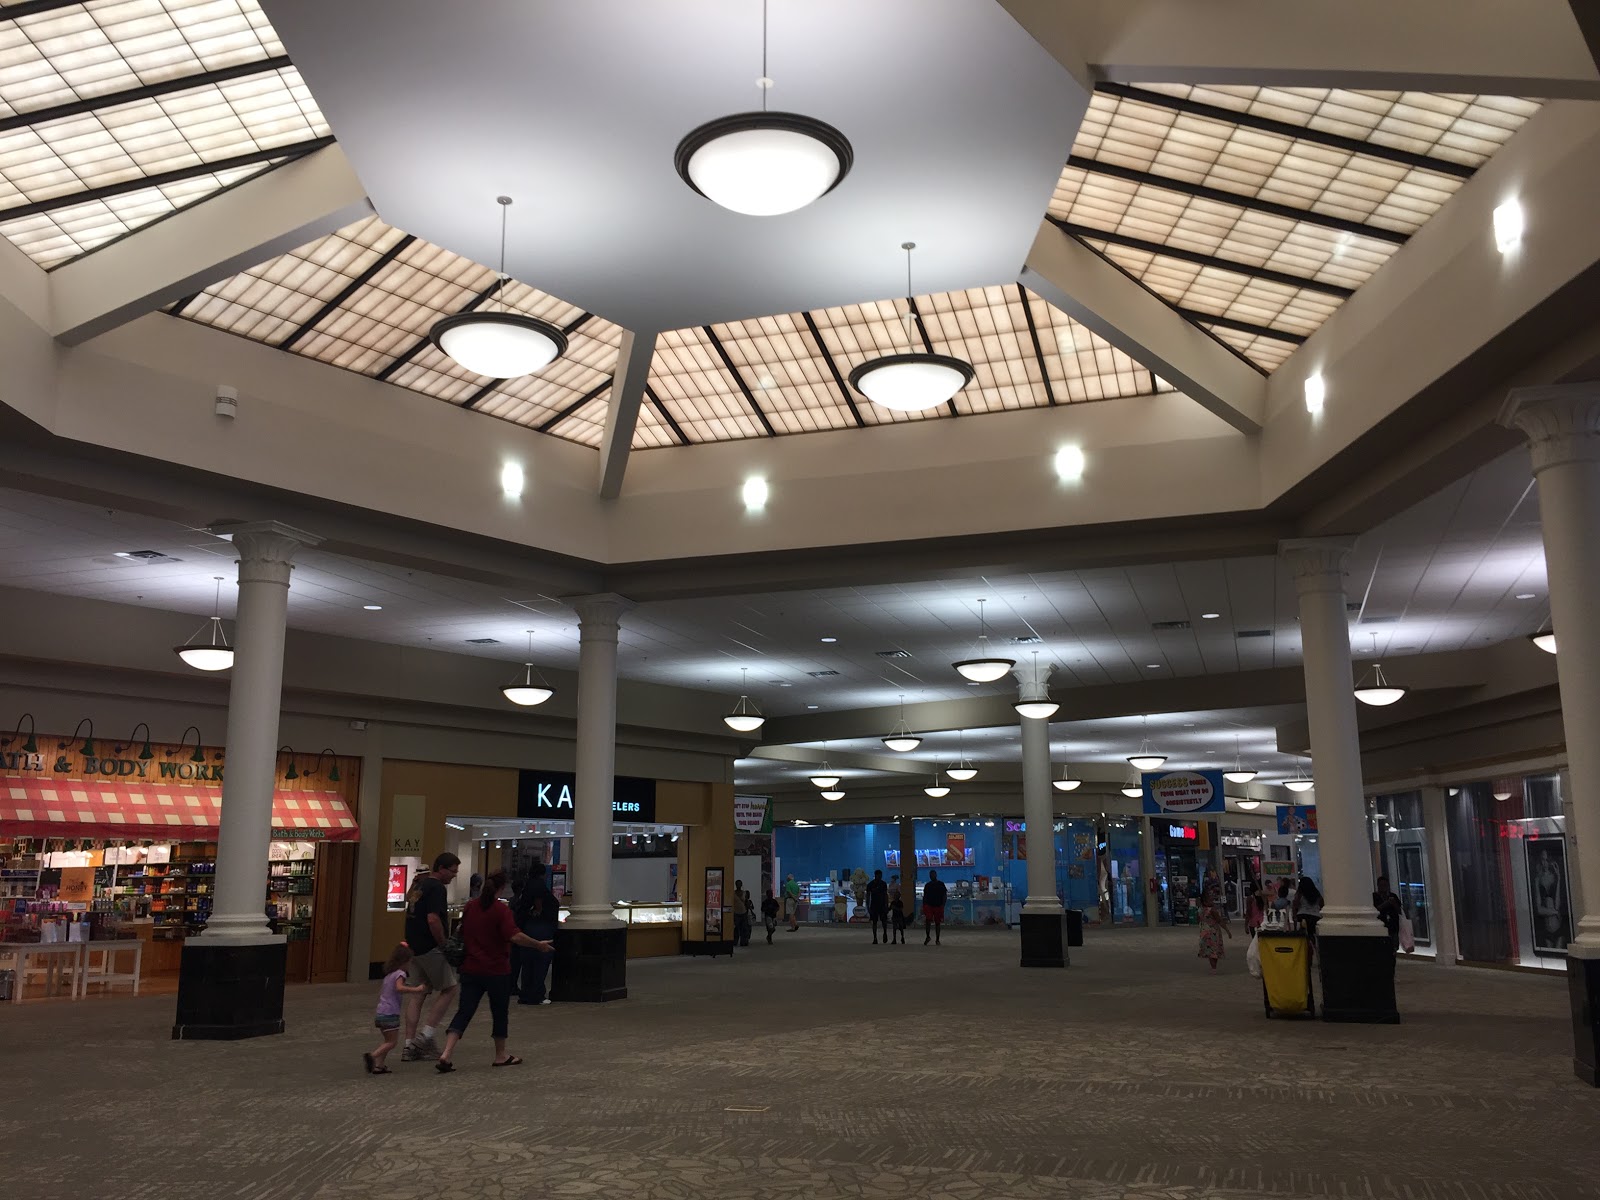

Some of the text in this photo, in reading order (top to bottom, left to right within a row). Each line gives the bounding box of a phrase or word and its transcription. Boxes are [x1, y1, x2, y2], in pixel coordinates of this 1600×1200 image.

[53, 755, 73, 773] &
[83, 757, 149, 777] BODY
[394, 838, 420, 848] KAY
